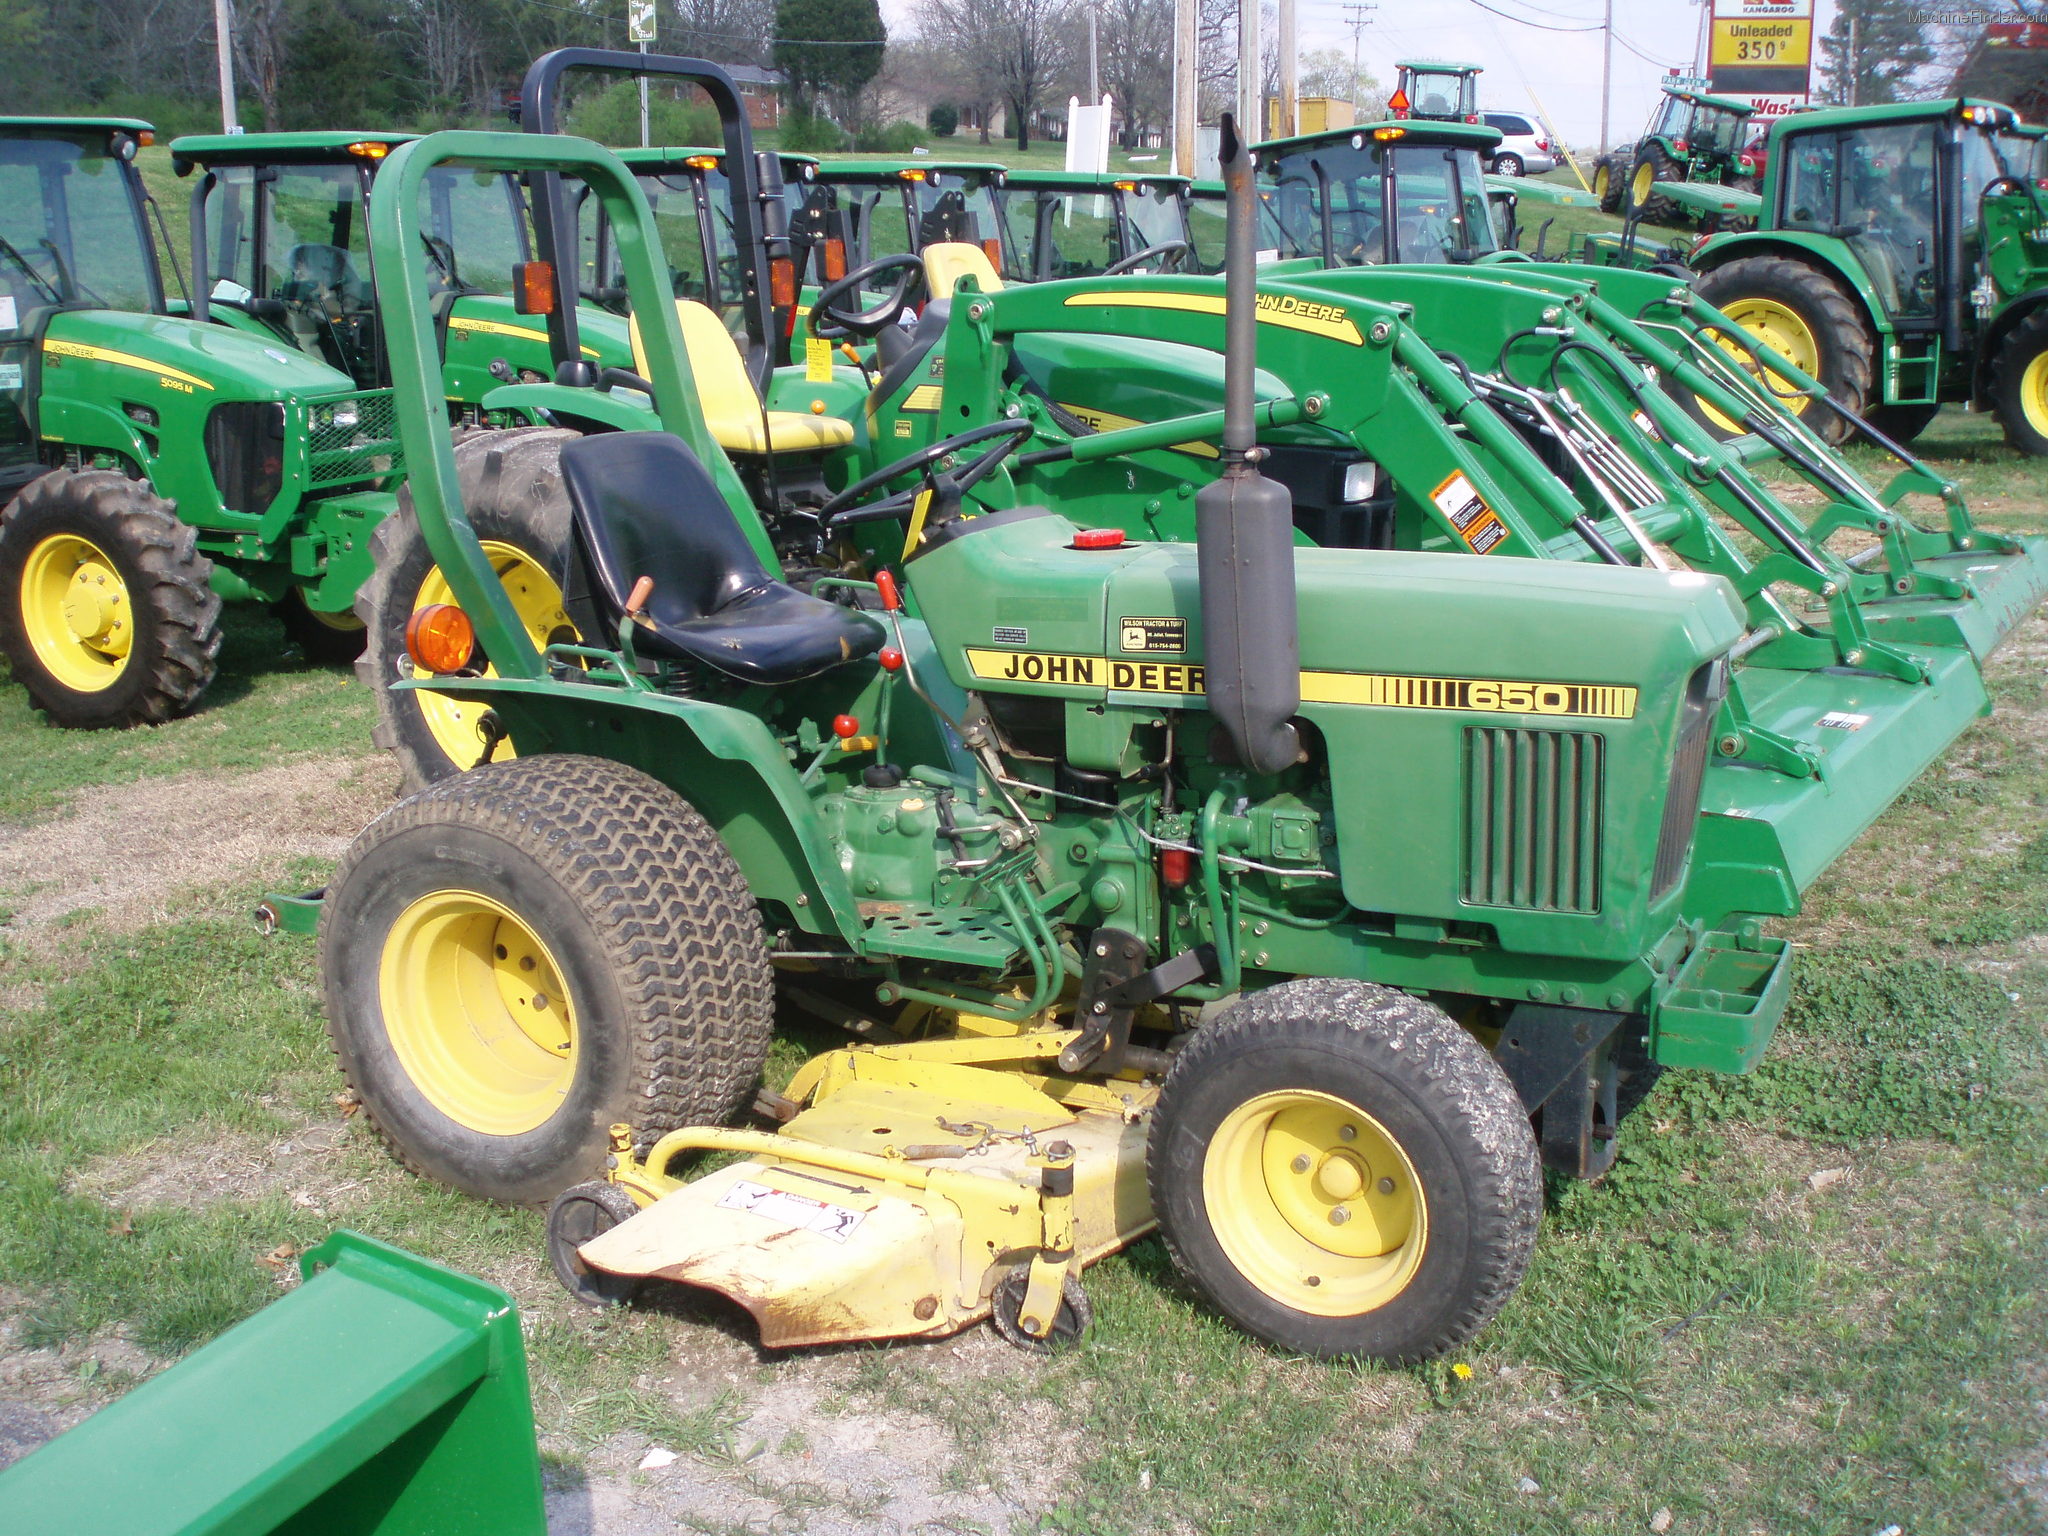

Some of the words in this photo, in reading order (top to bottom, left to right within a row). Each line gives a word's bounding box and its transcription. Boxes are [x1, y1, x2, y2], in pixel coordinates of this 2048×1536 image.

[1743, 5, 1795, 13] KANGAROO
[1730, 24, 1793, 37] Unleaded
[1737, 41, 1776, 60] 350
[1663, 77, 1681, 85] PARK
[1279, 295, 1345, 323] DEERE
[161, 377, 183, 390] 5095
[184, 384, 193, 394] M
[1004, 654, 1094, 683] JOHN
[1113, 663, 1206, 692] DEER
[1468, 682, 1569, 713] 650
